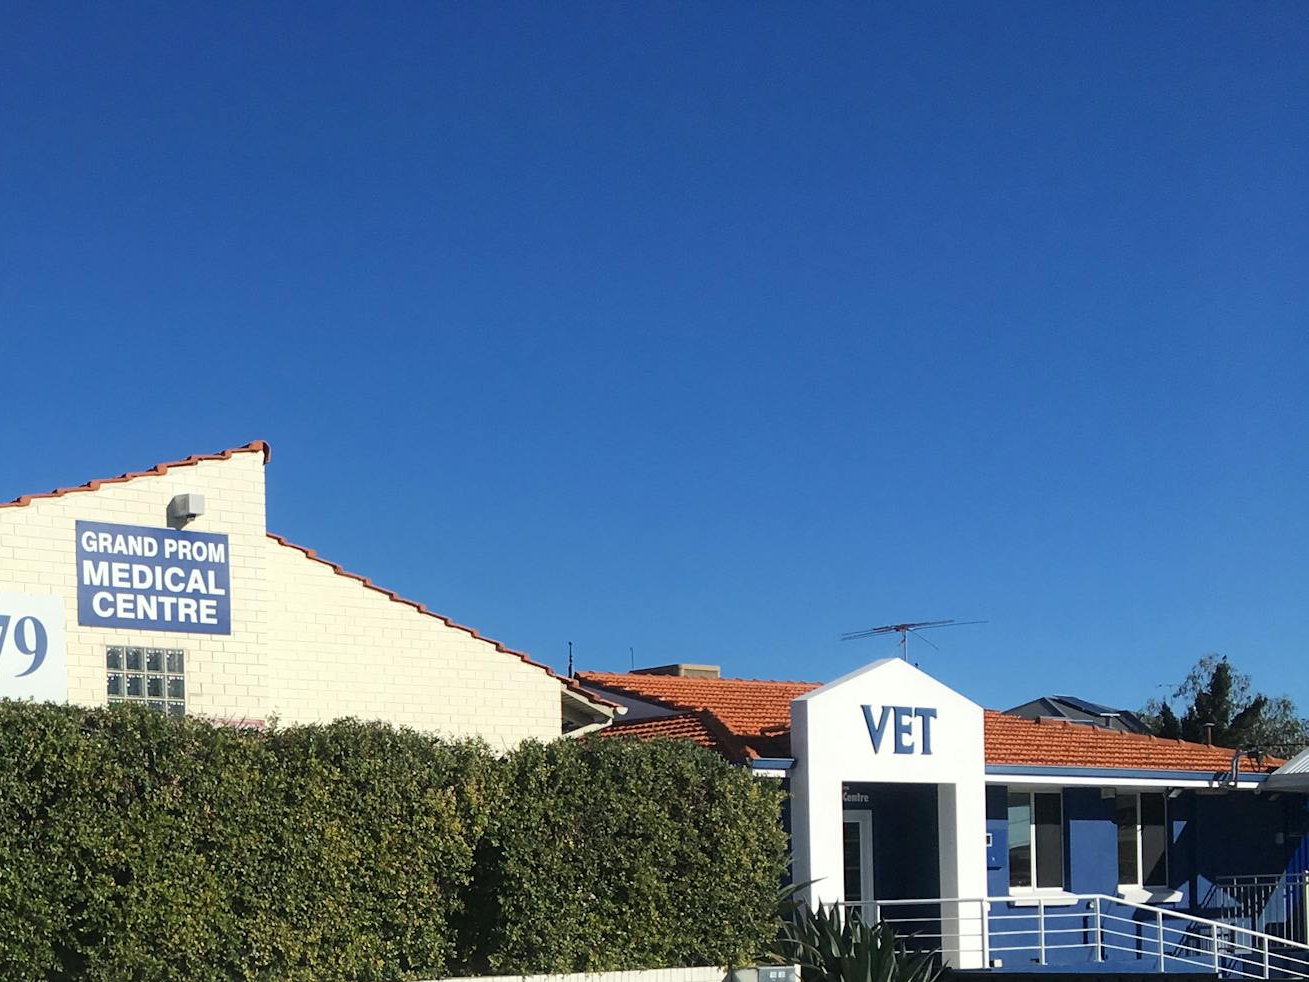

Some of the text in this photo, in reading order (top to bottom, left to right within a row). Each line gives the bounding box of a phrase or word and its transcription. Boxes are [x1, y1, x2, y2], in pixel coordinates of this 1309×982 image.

[81, 531, 225, 563] GRAND PROM
[83, 560, 226, 595] MEDICAL
[92, 591, 218, 624] CENTRE
[860, 704, 937, 755] VET
